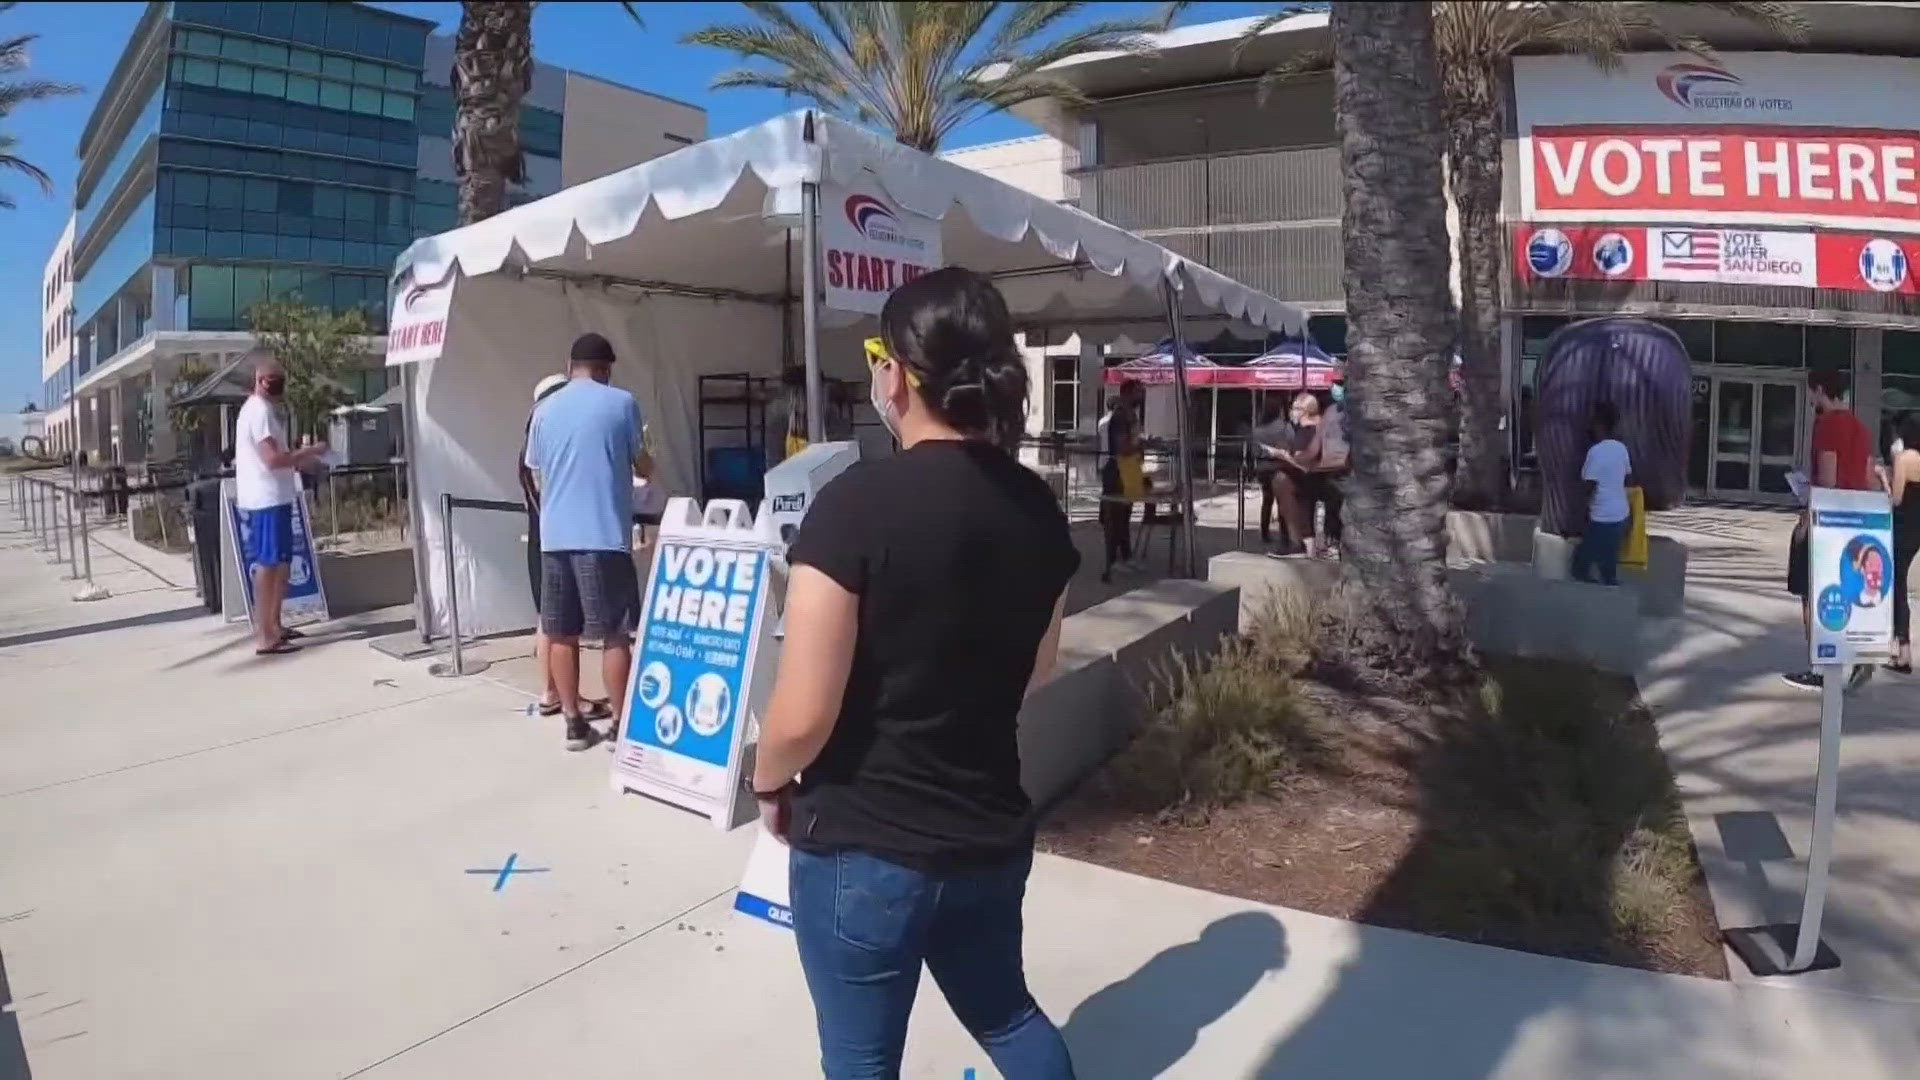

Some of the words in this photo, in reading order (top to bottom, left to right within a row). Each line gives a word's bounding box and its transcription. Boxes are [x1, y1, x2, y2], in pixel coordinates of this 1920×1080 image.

[1694, 97, 1742, 109] REGISTRAR
[1744, 98, 1757, 109] OF
[1759, 98, 1793, 111] VOTERS
[1539, 138, 1725, 197] VOTE
[1743, 140, 1919, 205] HERE
[1723, 232, 1762, 246] VOTE
[1723, 245, 1768, 259] SAFER
[827, 249, 896, 292] START
[1723, 259, 1753, 272] SAN
[1756, 260, 1802, 274] DIEGO
[389, 323, 420, 352] START
[420, 320, 444, 346] HERE
[664, 544, 758, 592] VOTE
[653, 583, 750, 634] HERE
